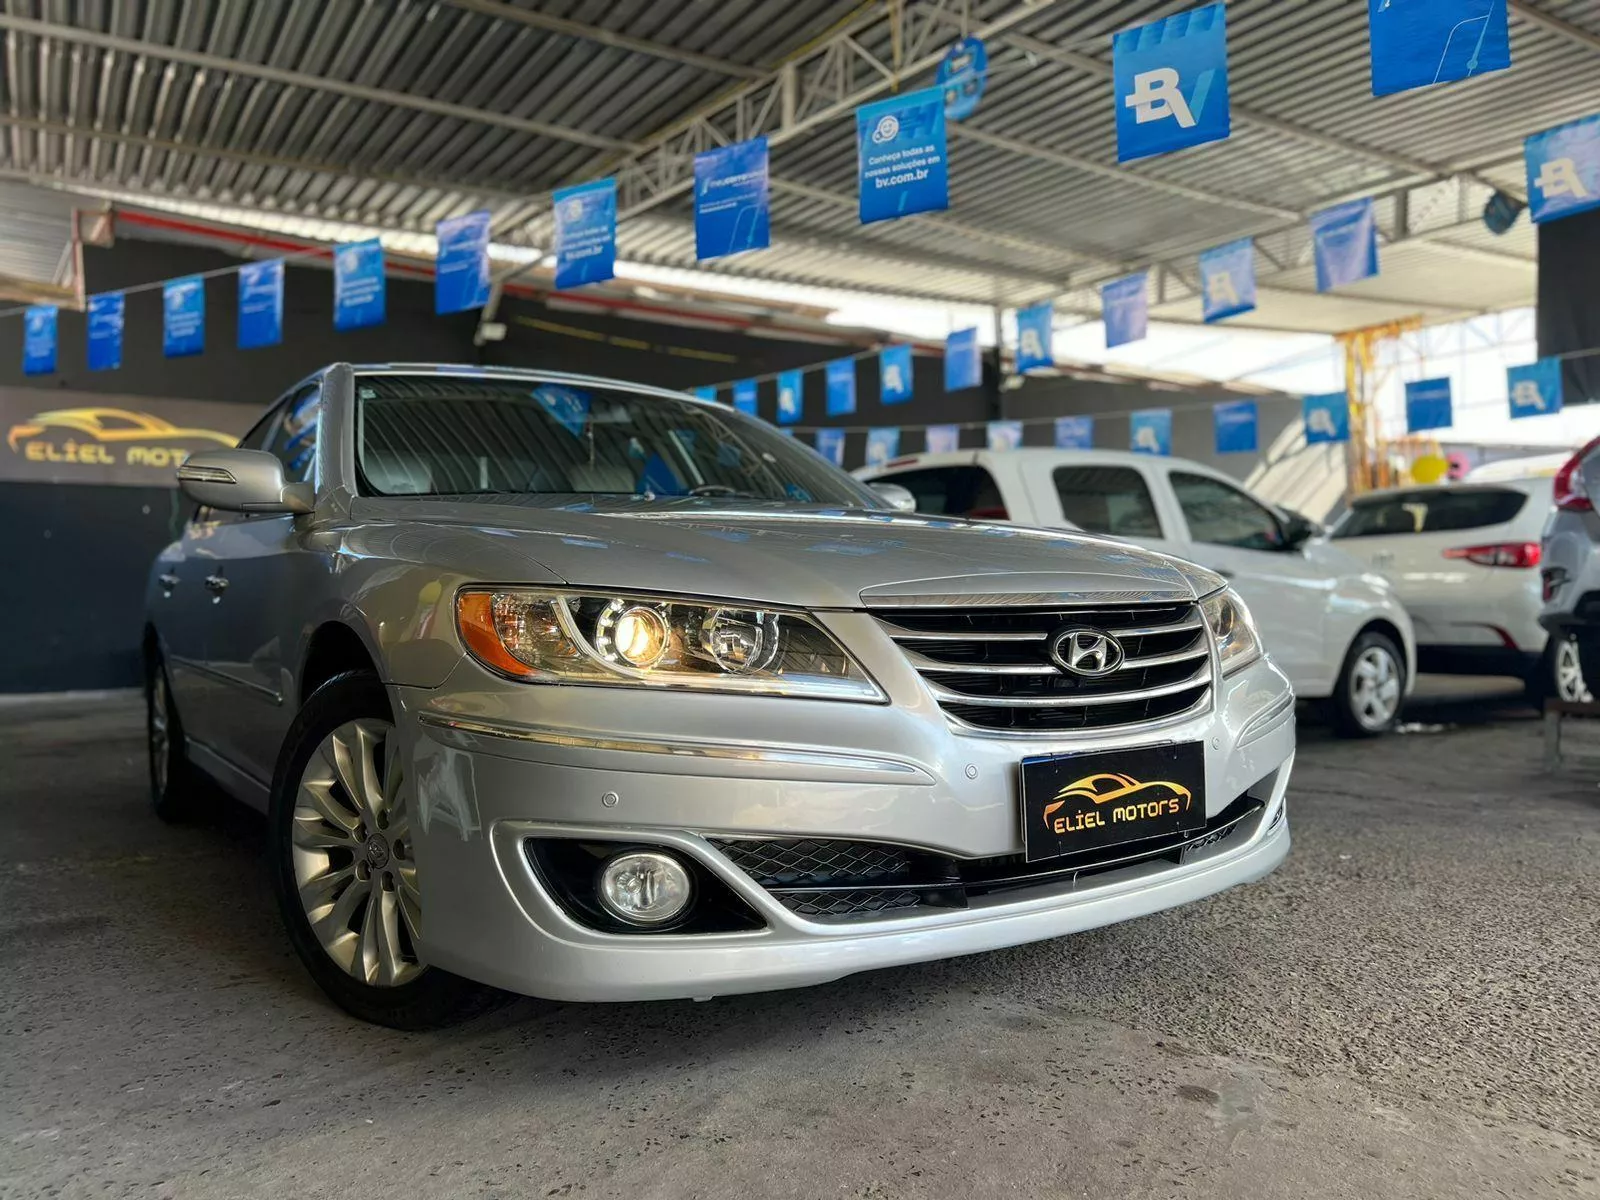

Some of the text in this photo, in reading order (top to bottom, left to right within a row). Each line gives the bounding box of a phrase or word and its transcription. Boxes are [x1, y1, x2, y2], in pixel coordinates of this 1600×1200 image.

[1125, 67, 1216, 129] BV
[865, 155, 941, 178] nossas soluções em
[868, 144, 936, 165] Conheça todas as
[875, 168, 929, 189] bv.com.br
[25, 439, 188, 468] ELIEL MOT
[1053, 798, 1180, 834] ELIEL MOTORS
